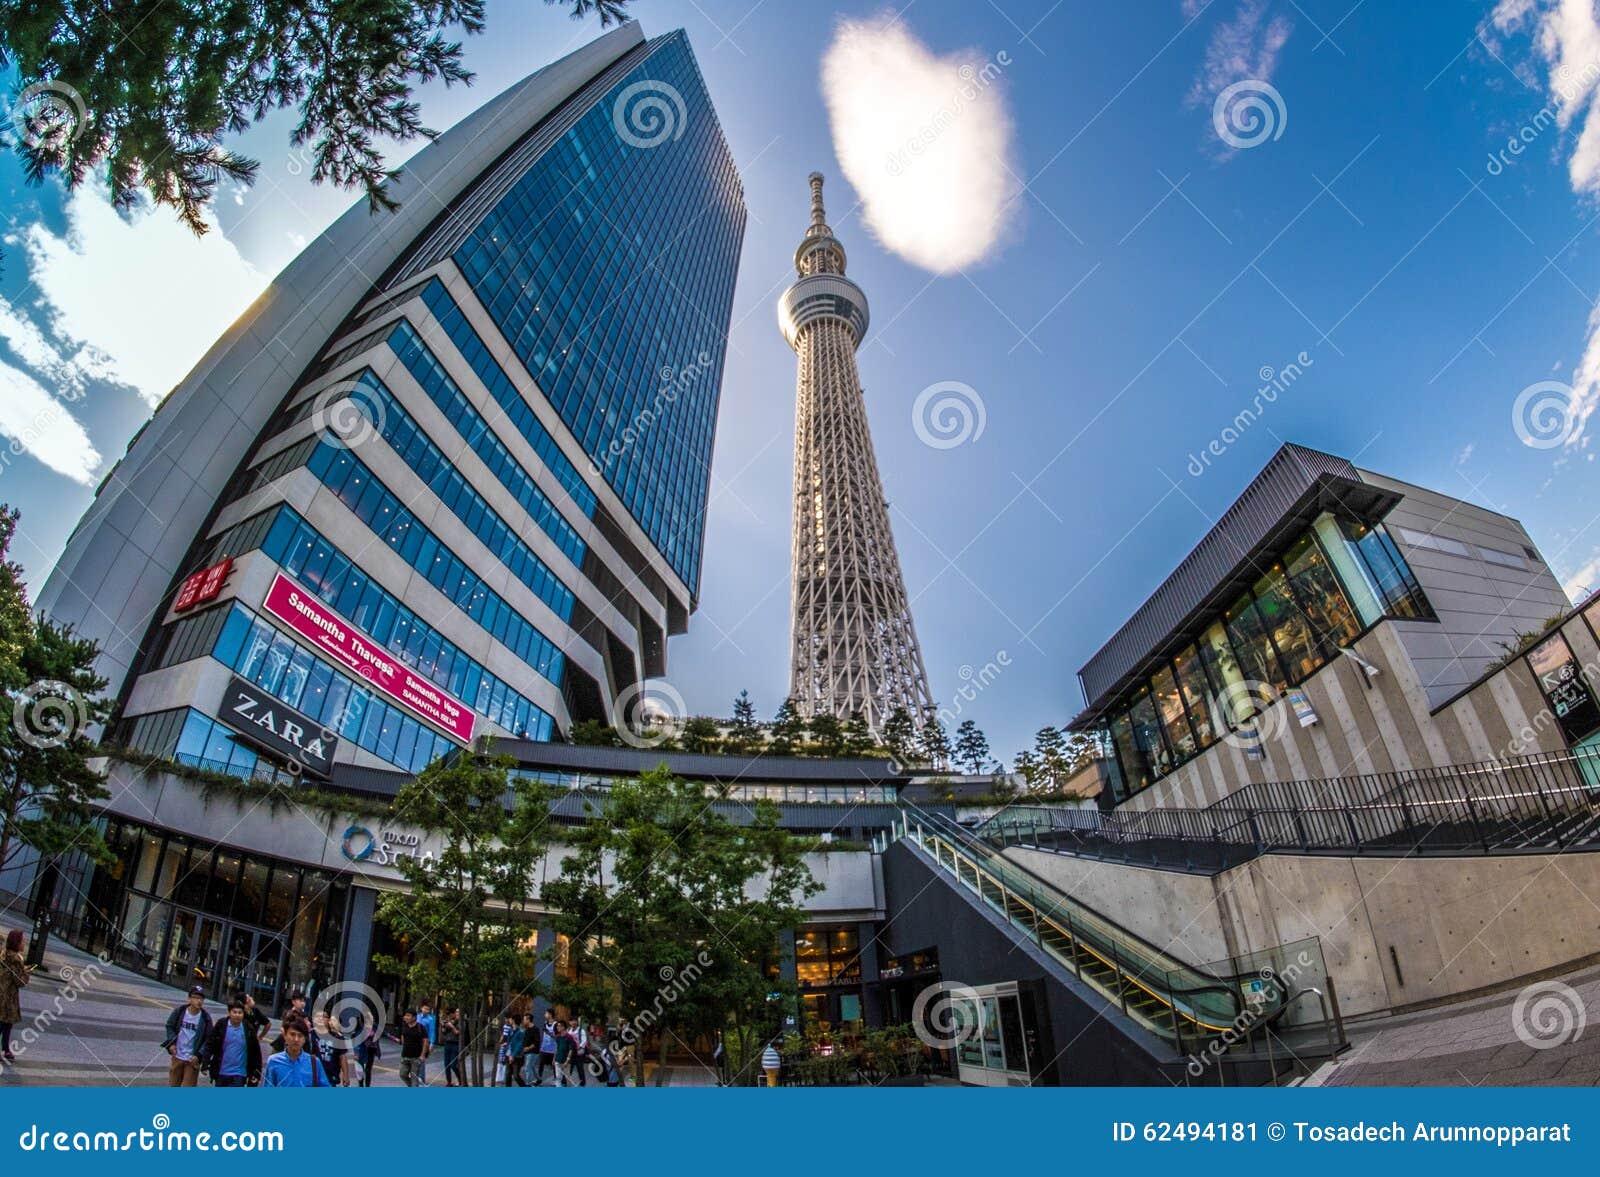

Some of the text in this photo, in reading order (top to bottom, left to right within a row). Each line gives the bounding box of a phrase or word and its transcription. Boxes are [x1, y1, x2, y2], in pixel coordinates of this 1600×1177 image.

[288, 592, 396, 678] Samantha Thavasa
[402, 689, 440, 718] SAMANTHA
[405, 675, 460, 718] Samantha Vega
[232, 692, 326, 761] ZARA
